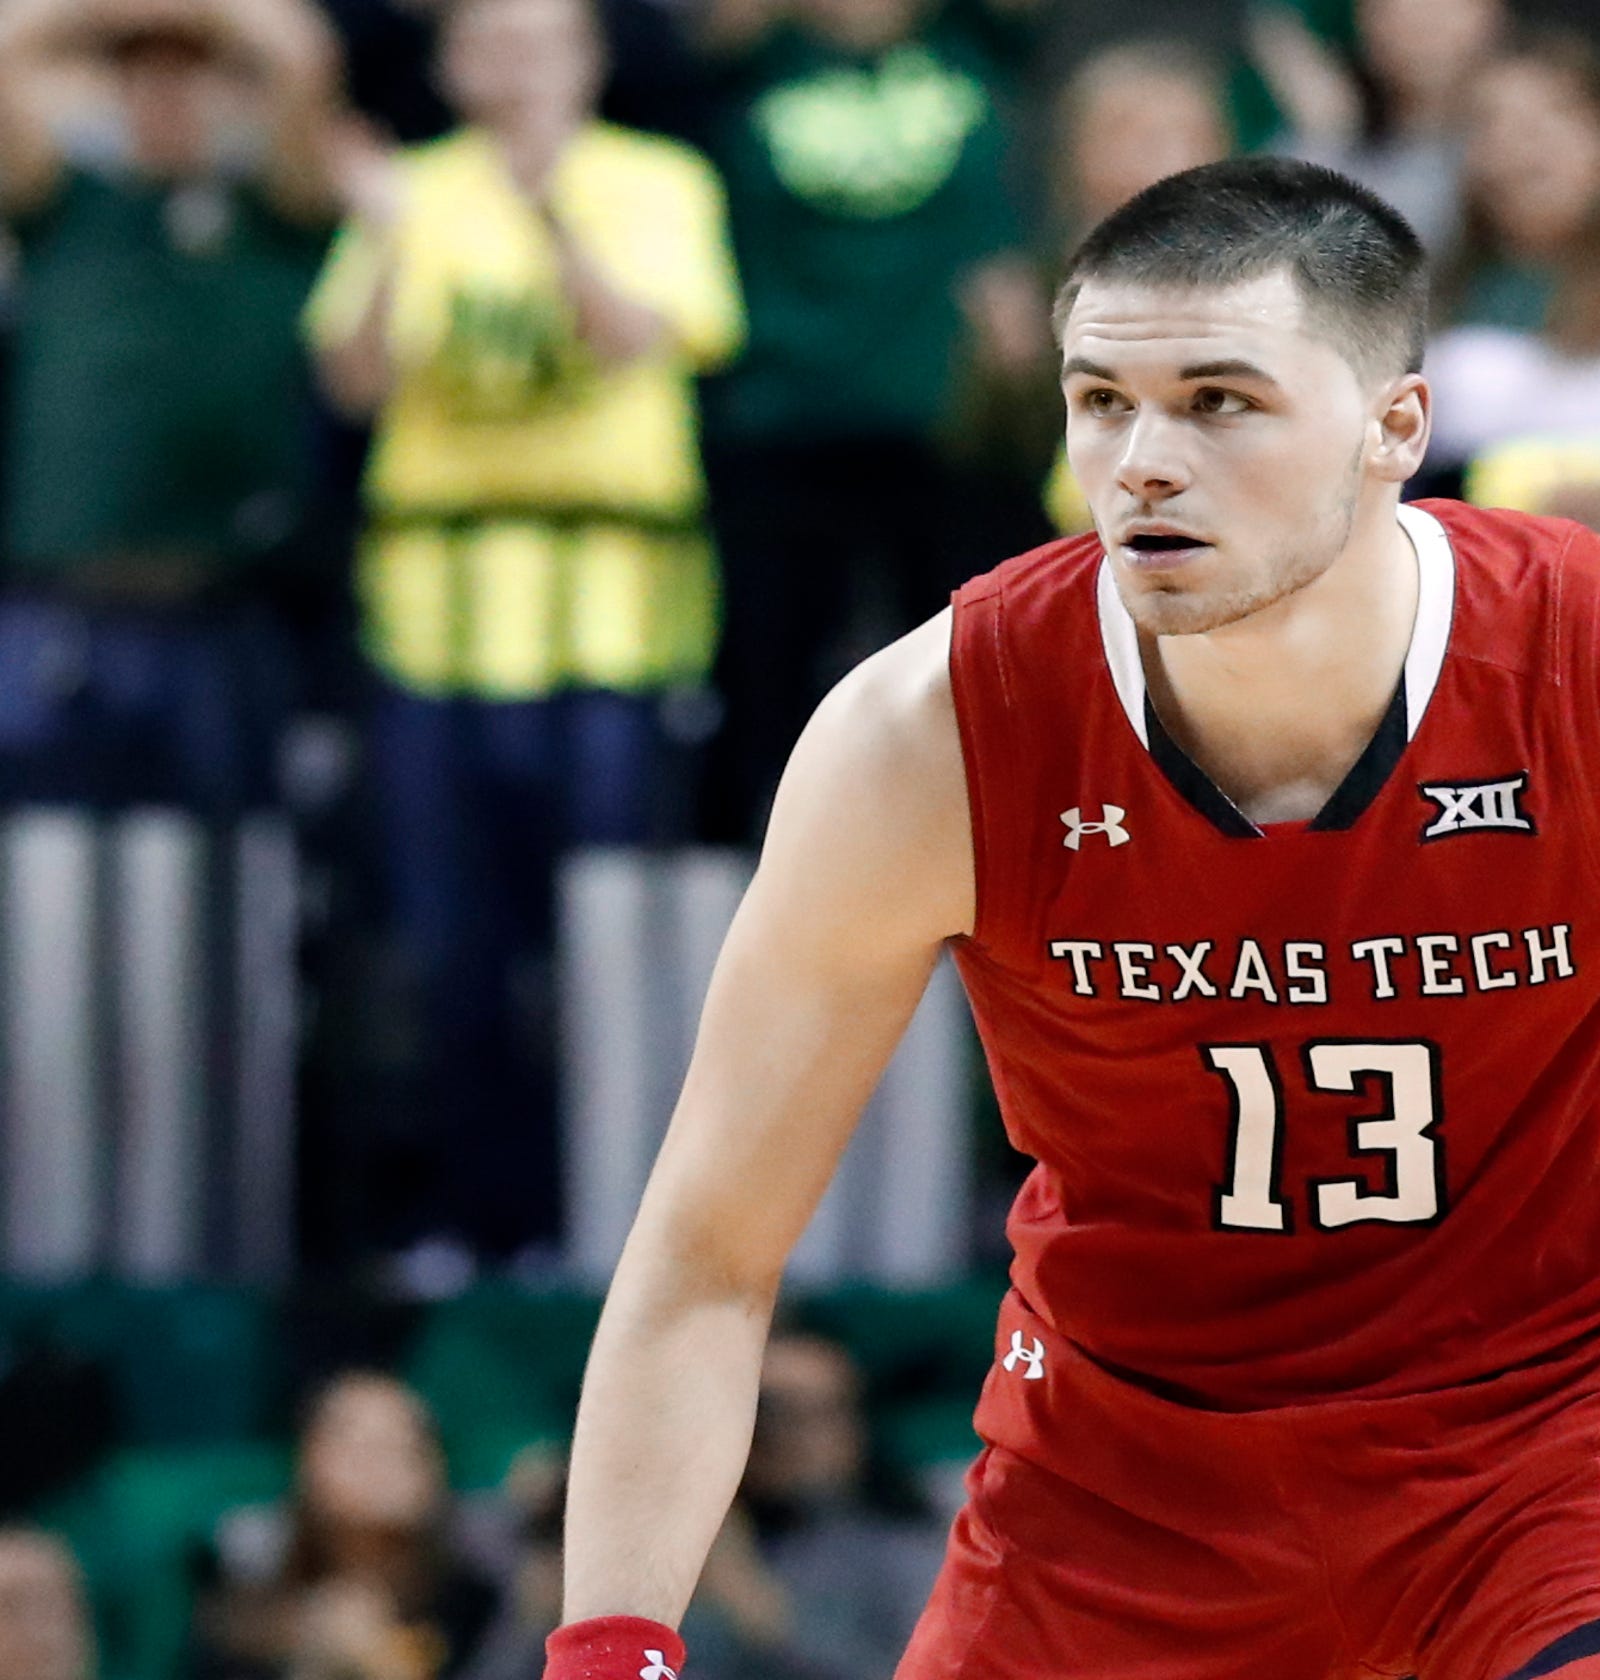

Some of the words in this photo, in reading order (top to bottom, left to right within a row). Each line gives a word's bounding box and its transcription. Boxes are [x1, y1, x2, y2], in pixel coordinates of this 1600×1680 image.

[1421, 776, 1533, 839] XII
[1050, 939, 1328, 1003] TEXAS
[1351, 923, 1575, 999] TECH
[1203, 1041, 1442, 1234] 13
